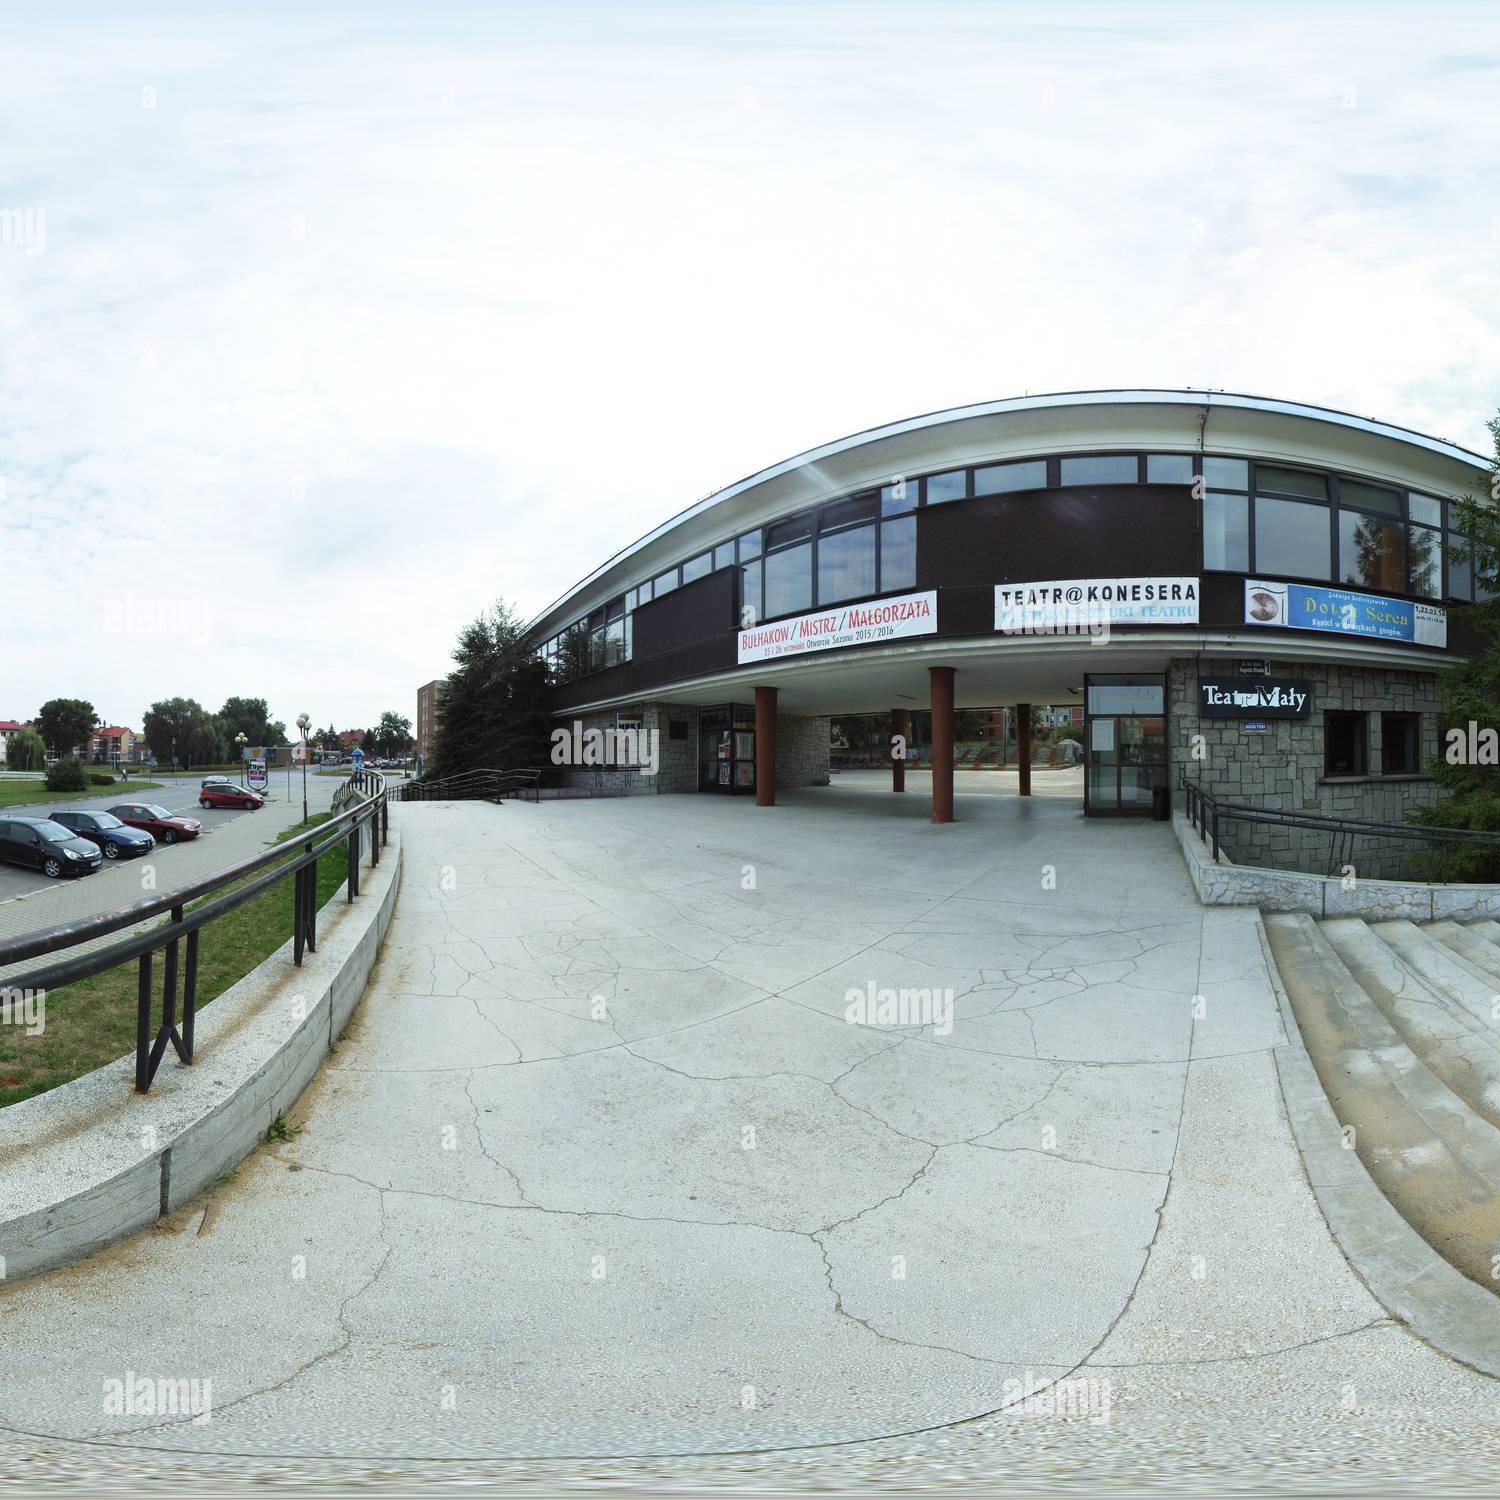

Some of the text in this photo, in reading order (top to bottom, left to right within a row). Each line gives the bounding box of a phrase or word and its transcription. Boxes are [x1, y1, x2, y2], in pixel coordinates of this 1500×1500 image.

[743, 626, 789, 650] BUŁHAKOW
[799, 616, 836, 638] MISTRZ
[849, 600, 930, 629] MAŁGORZATA
[1366, 607, 1408, 625] Serca
[806, 637, 830, 648] Otwarcie
[855, 625, 894, 640] 2015/2016
[1256, 686, 1306, 712] Mały
